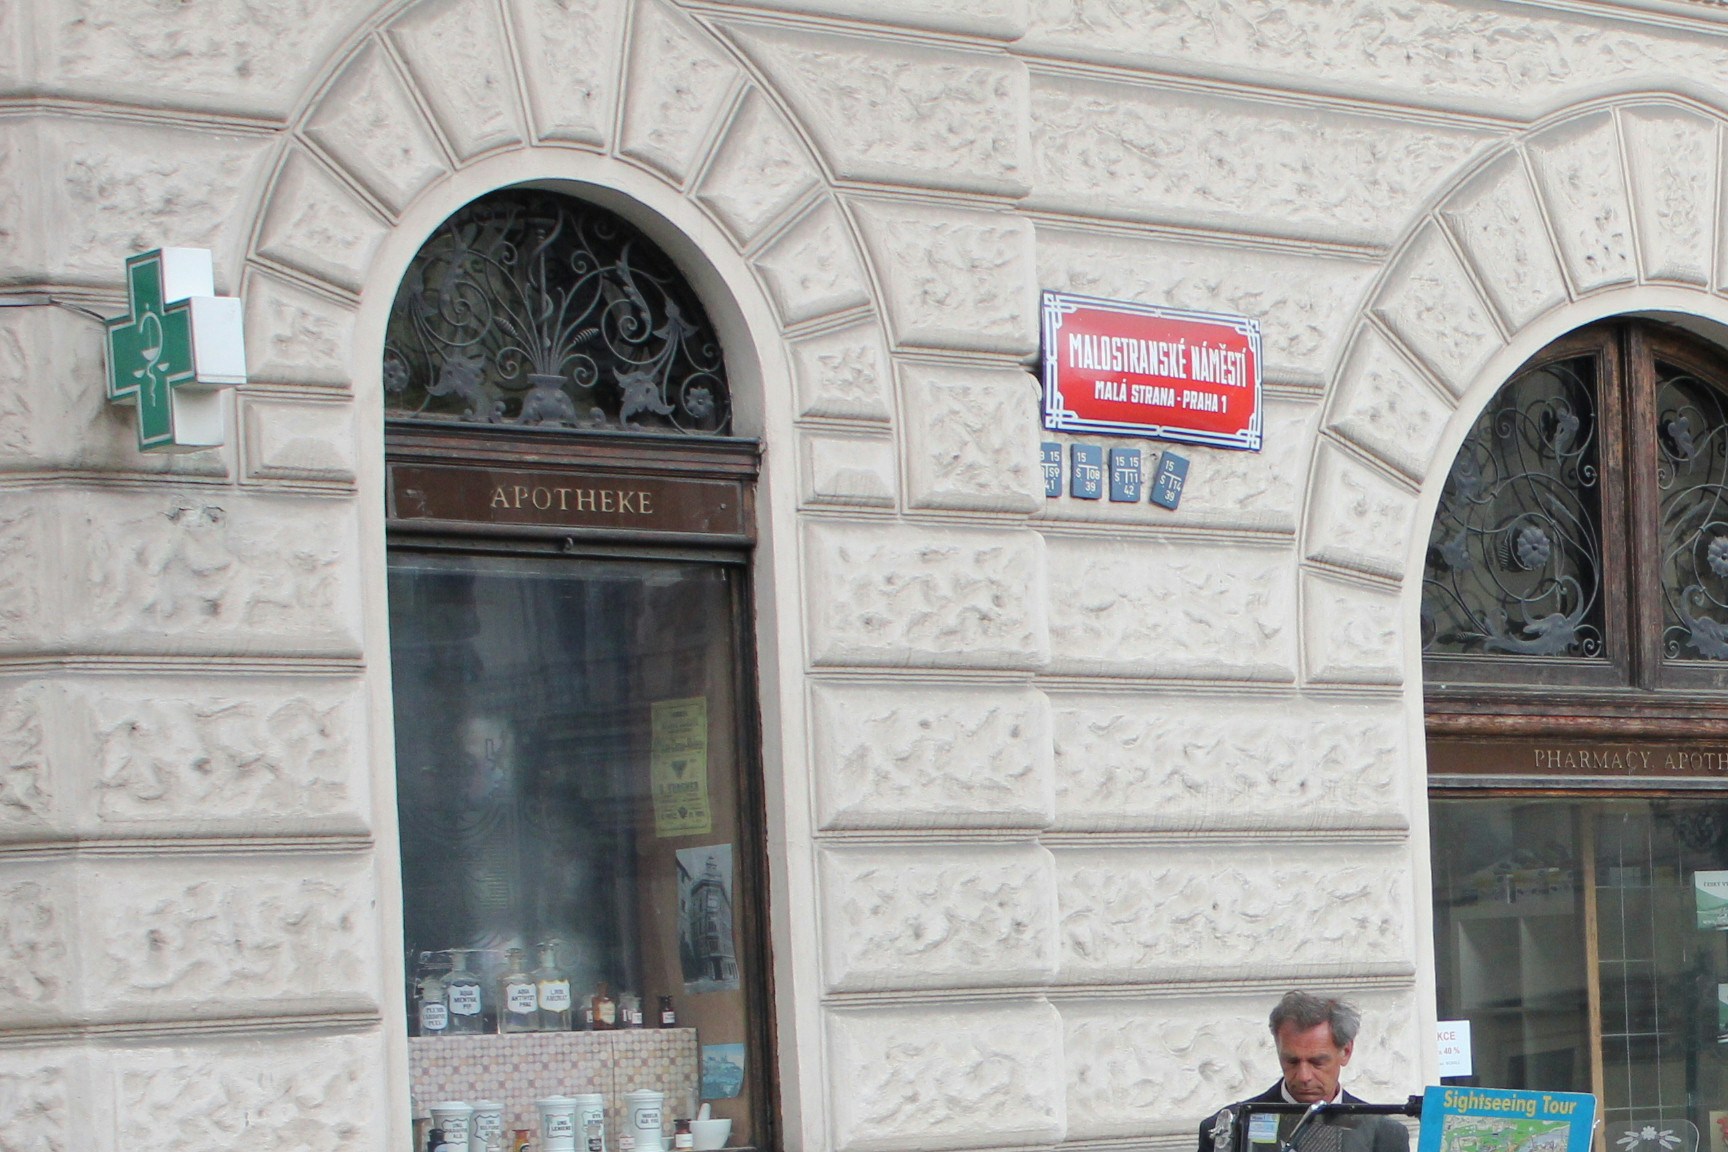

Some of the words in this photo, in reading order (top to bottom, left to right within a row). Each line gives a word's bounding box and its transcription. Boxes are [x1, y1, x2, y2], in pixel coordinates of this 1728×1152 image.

[1069, 333, 1187, 378] MALOSTRANSKÉ
[1191, 340, 1247, 387] NÁMĚSTÍ
[1094, 379, 1127, 402] MALÁ
[1131, 384, 1175, 407] STRANA
[1182, 390, 1218, 412] PRAHA
[1221, 395, 1227, 413] 1
[1050, 452, 1059, 461] 15
[1077, 452, 1087, 462] 15
[1115, 456, 1125, 466] 15
[1130, 457, 1139, 467] 15
[1166, 460, 1174, 471] 15
[490, 485, 654, 514] APOTHEKE
[1437, 1031, 1456, 1041] KCE
[1443, 1090, 1537, 1117] Sightseeing
[1543, 1095, 1578, 1115] Tour
